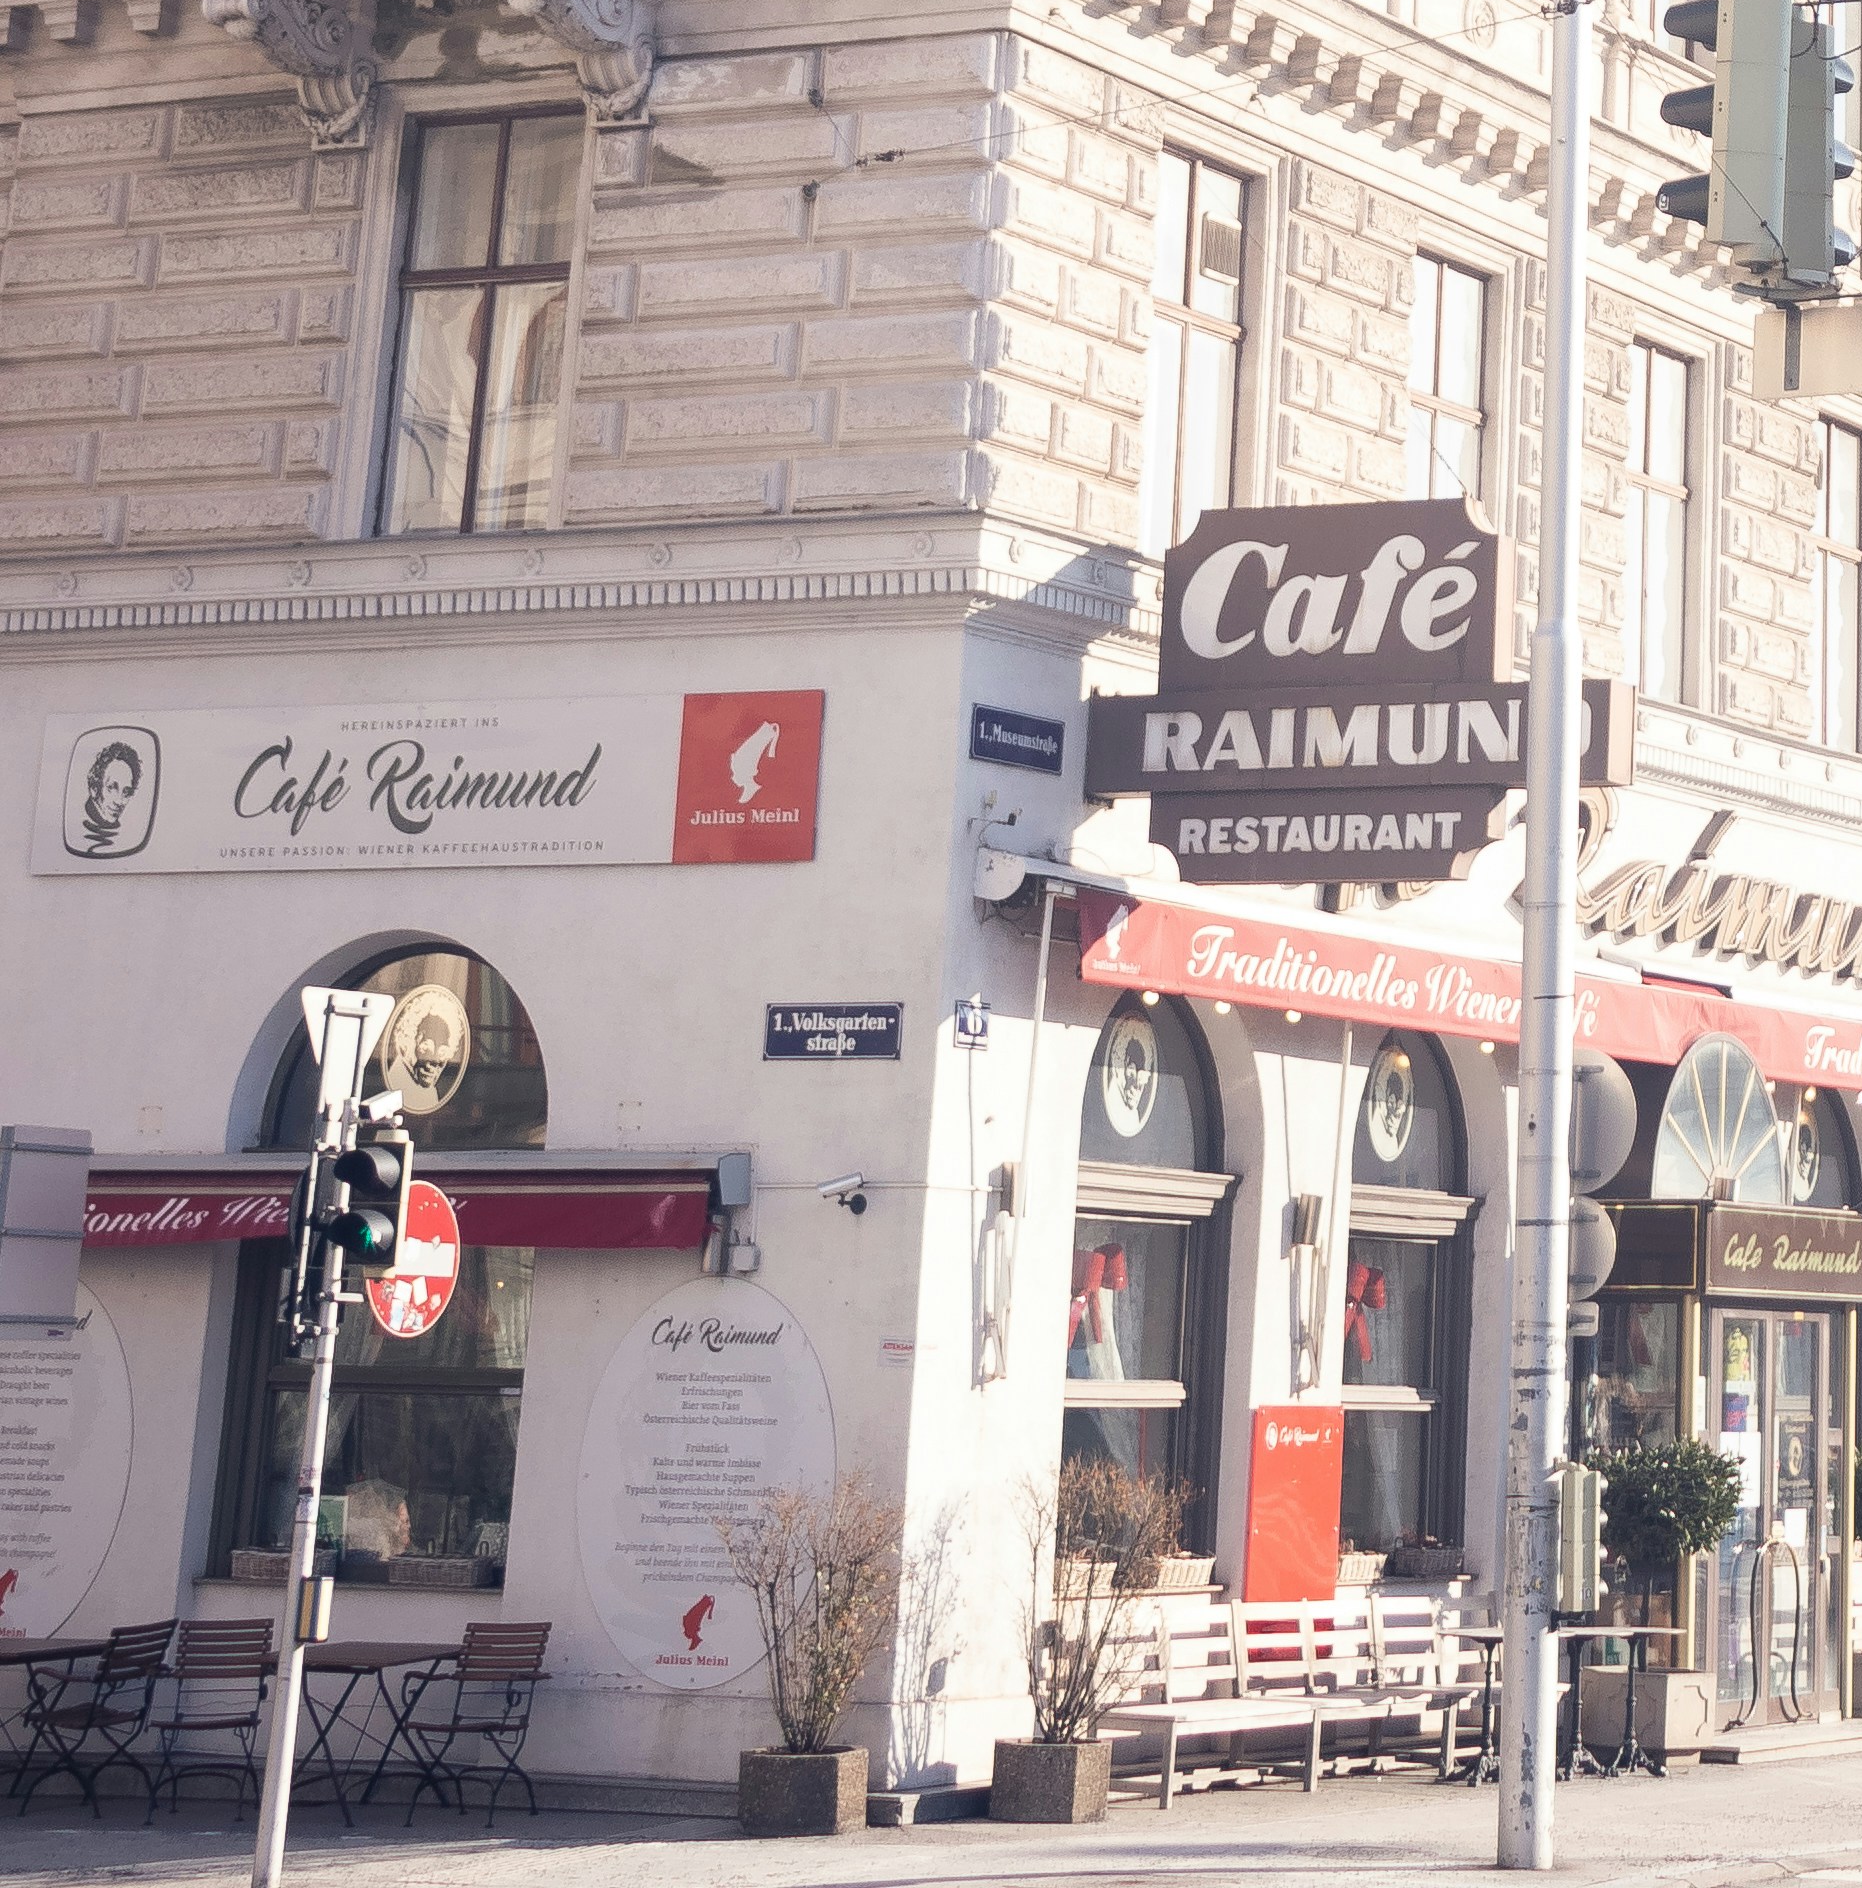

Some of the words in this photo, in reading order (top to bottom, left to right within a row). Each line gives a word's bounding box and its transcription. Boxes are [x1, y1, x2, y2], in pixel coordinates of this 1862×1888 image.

[1181, 535, 1482, 659] Café
[341, 718, 467, 732] HEREINSPAZIERT
[474, 716, 500, 728] INS
[1141, 699, 1592, 773] RAIMUN
[234, 735, 351, 836] Café
[367, 738, 602, 835] Raimund
[690, 808, 745, 825] Julius
[751, 807, 800, 824] Meinl
[1178, 812, 1462, 855] RESTAURANT
[219, 846, 275, 858] UNSERE
[358, 844, 414, 856] WIENER
[421, 841, 604, 855] KAFFEEHAUSTRADITION
[1187, 924, 1418, 1012] Traditionelles
[1424, 962, 1523, 1026] Wiener
[1573, 990, 1600, 1036] fé
[807, 1032, 857, 1056] straße
[83, 1198, 209, 1232] ionelles
[1773, 1234, 1862, 1274] Raimund
[652, 1315, 694, 1352] Café
[700, 1318, 784, 1352] Raimund
[655, 1654, 692, 1666] Julius
[696, 1655, 729, 1667] Meinl
